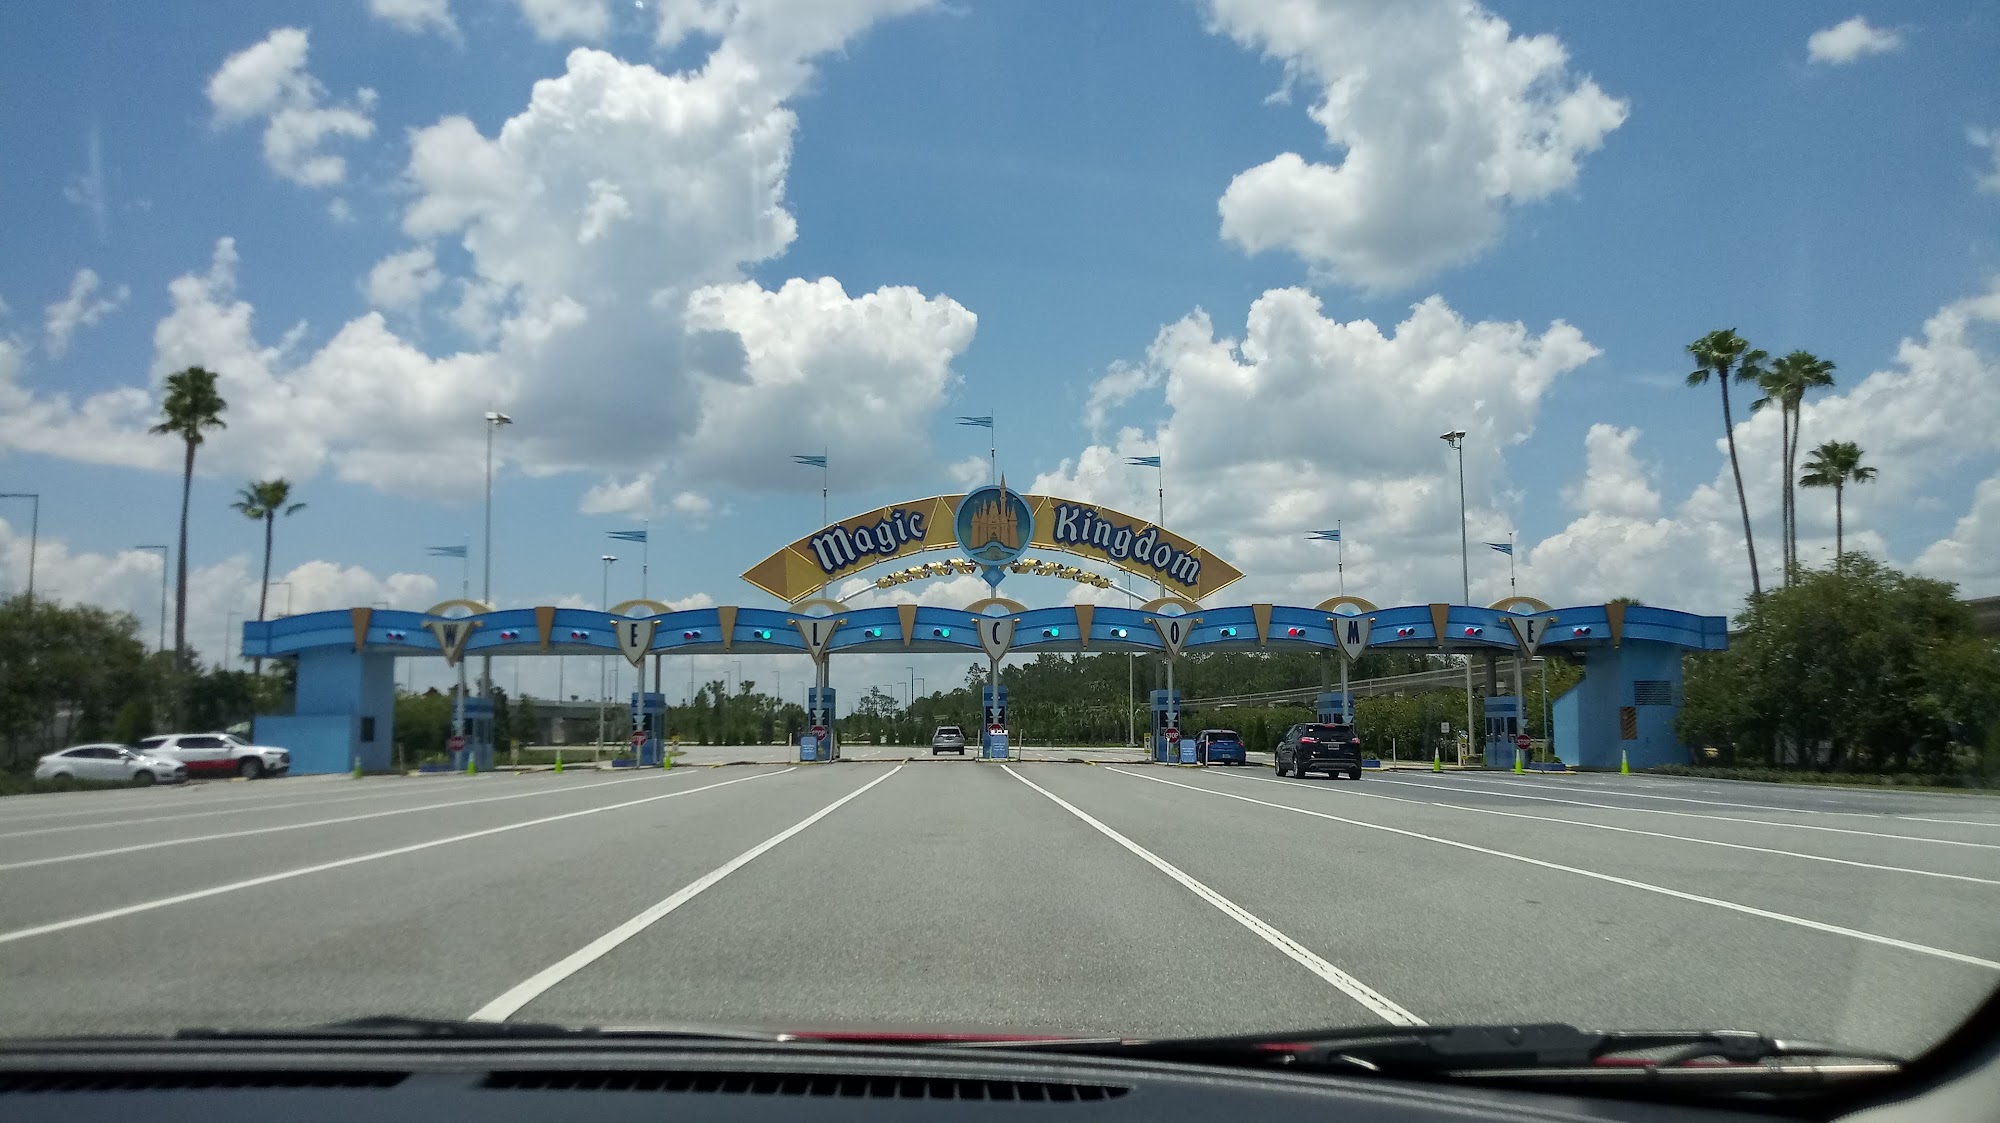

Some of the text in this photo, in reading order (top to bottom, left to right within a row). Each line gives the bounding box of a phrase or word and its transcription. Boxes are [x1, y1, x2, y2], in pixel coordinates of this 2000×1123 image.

[810, 505, 1201, 584] Magic Kingdom
[442, 619, 1535, 648] W E L C O M E
